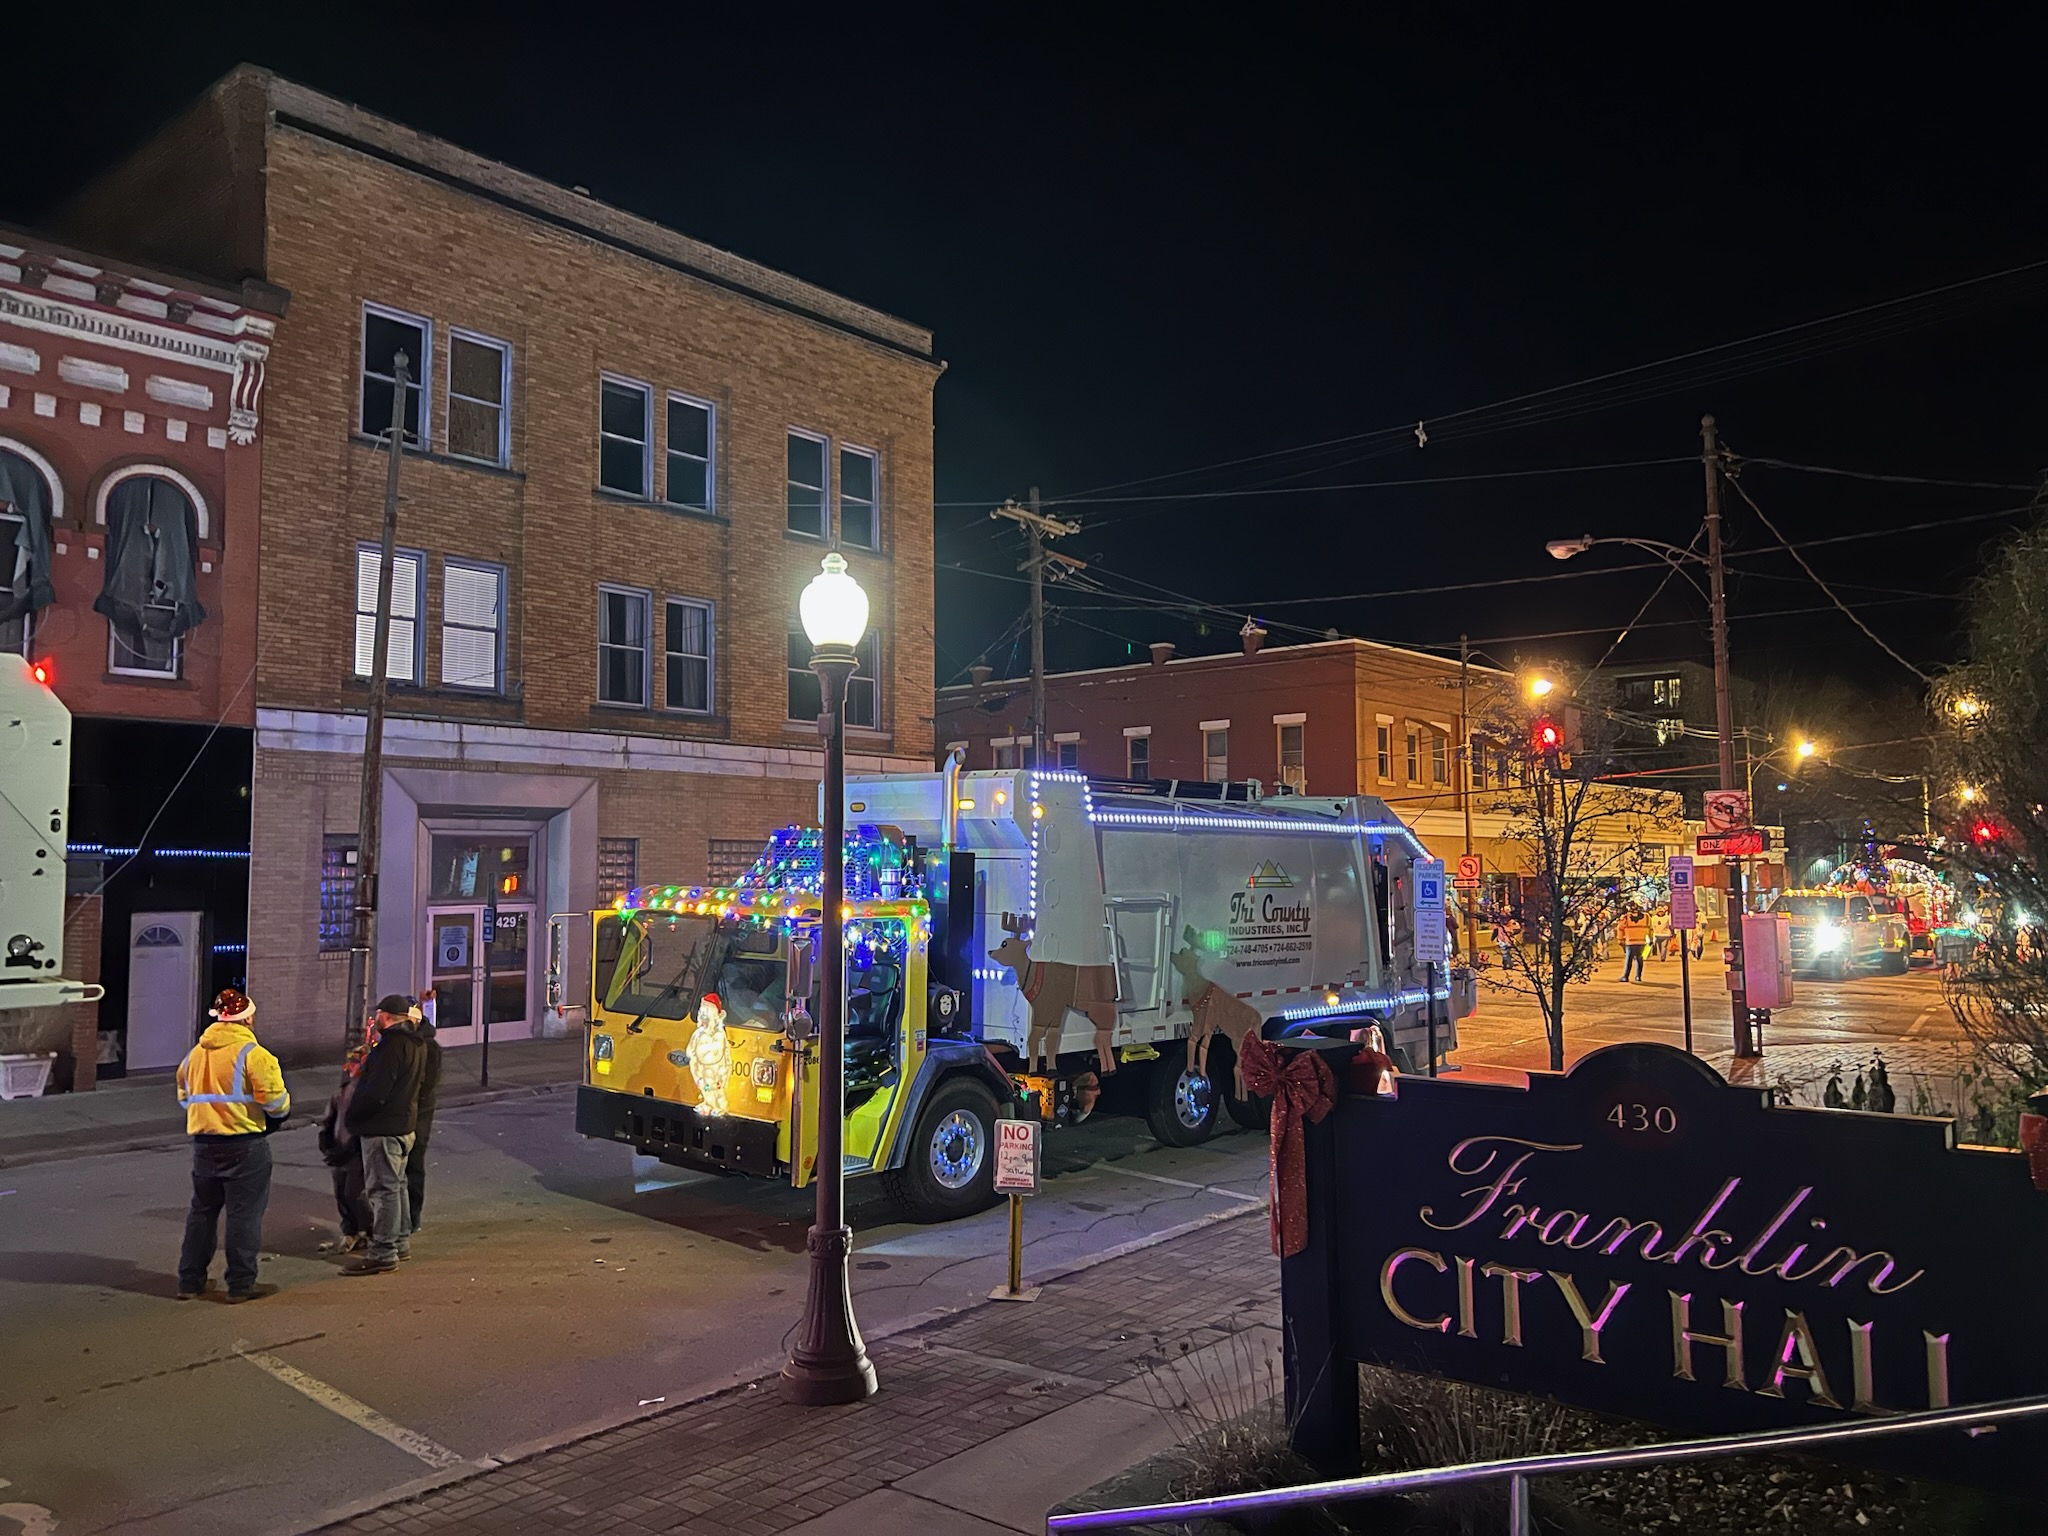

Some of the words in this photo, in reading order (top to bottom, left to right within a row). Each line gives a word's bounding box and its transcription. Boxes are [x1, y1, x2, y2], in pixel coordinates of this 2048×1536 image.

[1703, 841, 1721, 849] ONE
[1416, 863, 1443, 871] RESERVED
[1230, 892, 1256, 924] Tri
[1262, 893, 1311, 932] County
[496, 916, 516, 928] 429
[1228, 925, 1285, 936] INDUSTRIES,
[1286, 924, 1304, 933] INC.
[1606, 1103, 1678, 1134] 430
[1004, 1125, 1029, 1140] NO
[1000, 1142, 1034, 1151] PARKING
[1420, 1136, 1925, 1294] Franklin
[1380, 1245, 1632, 1364] CITY
